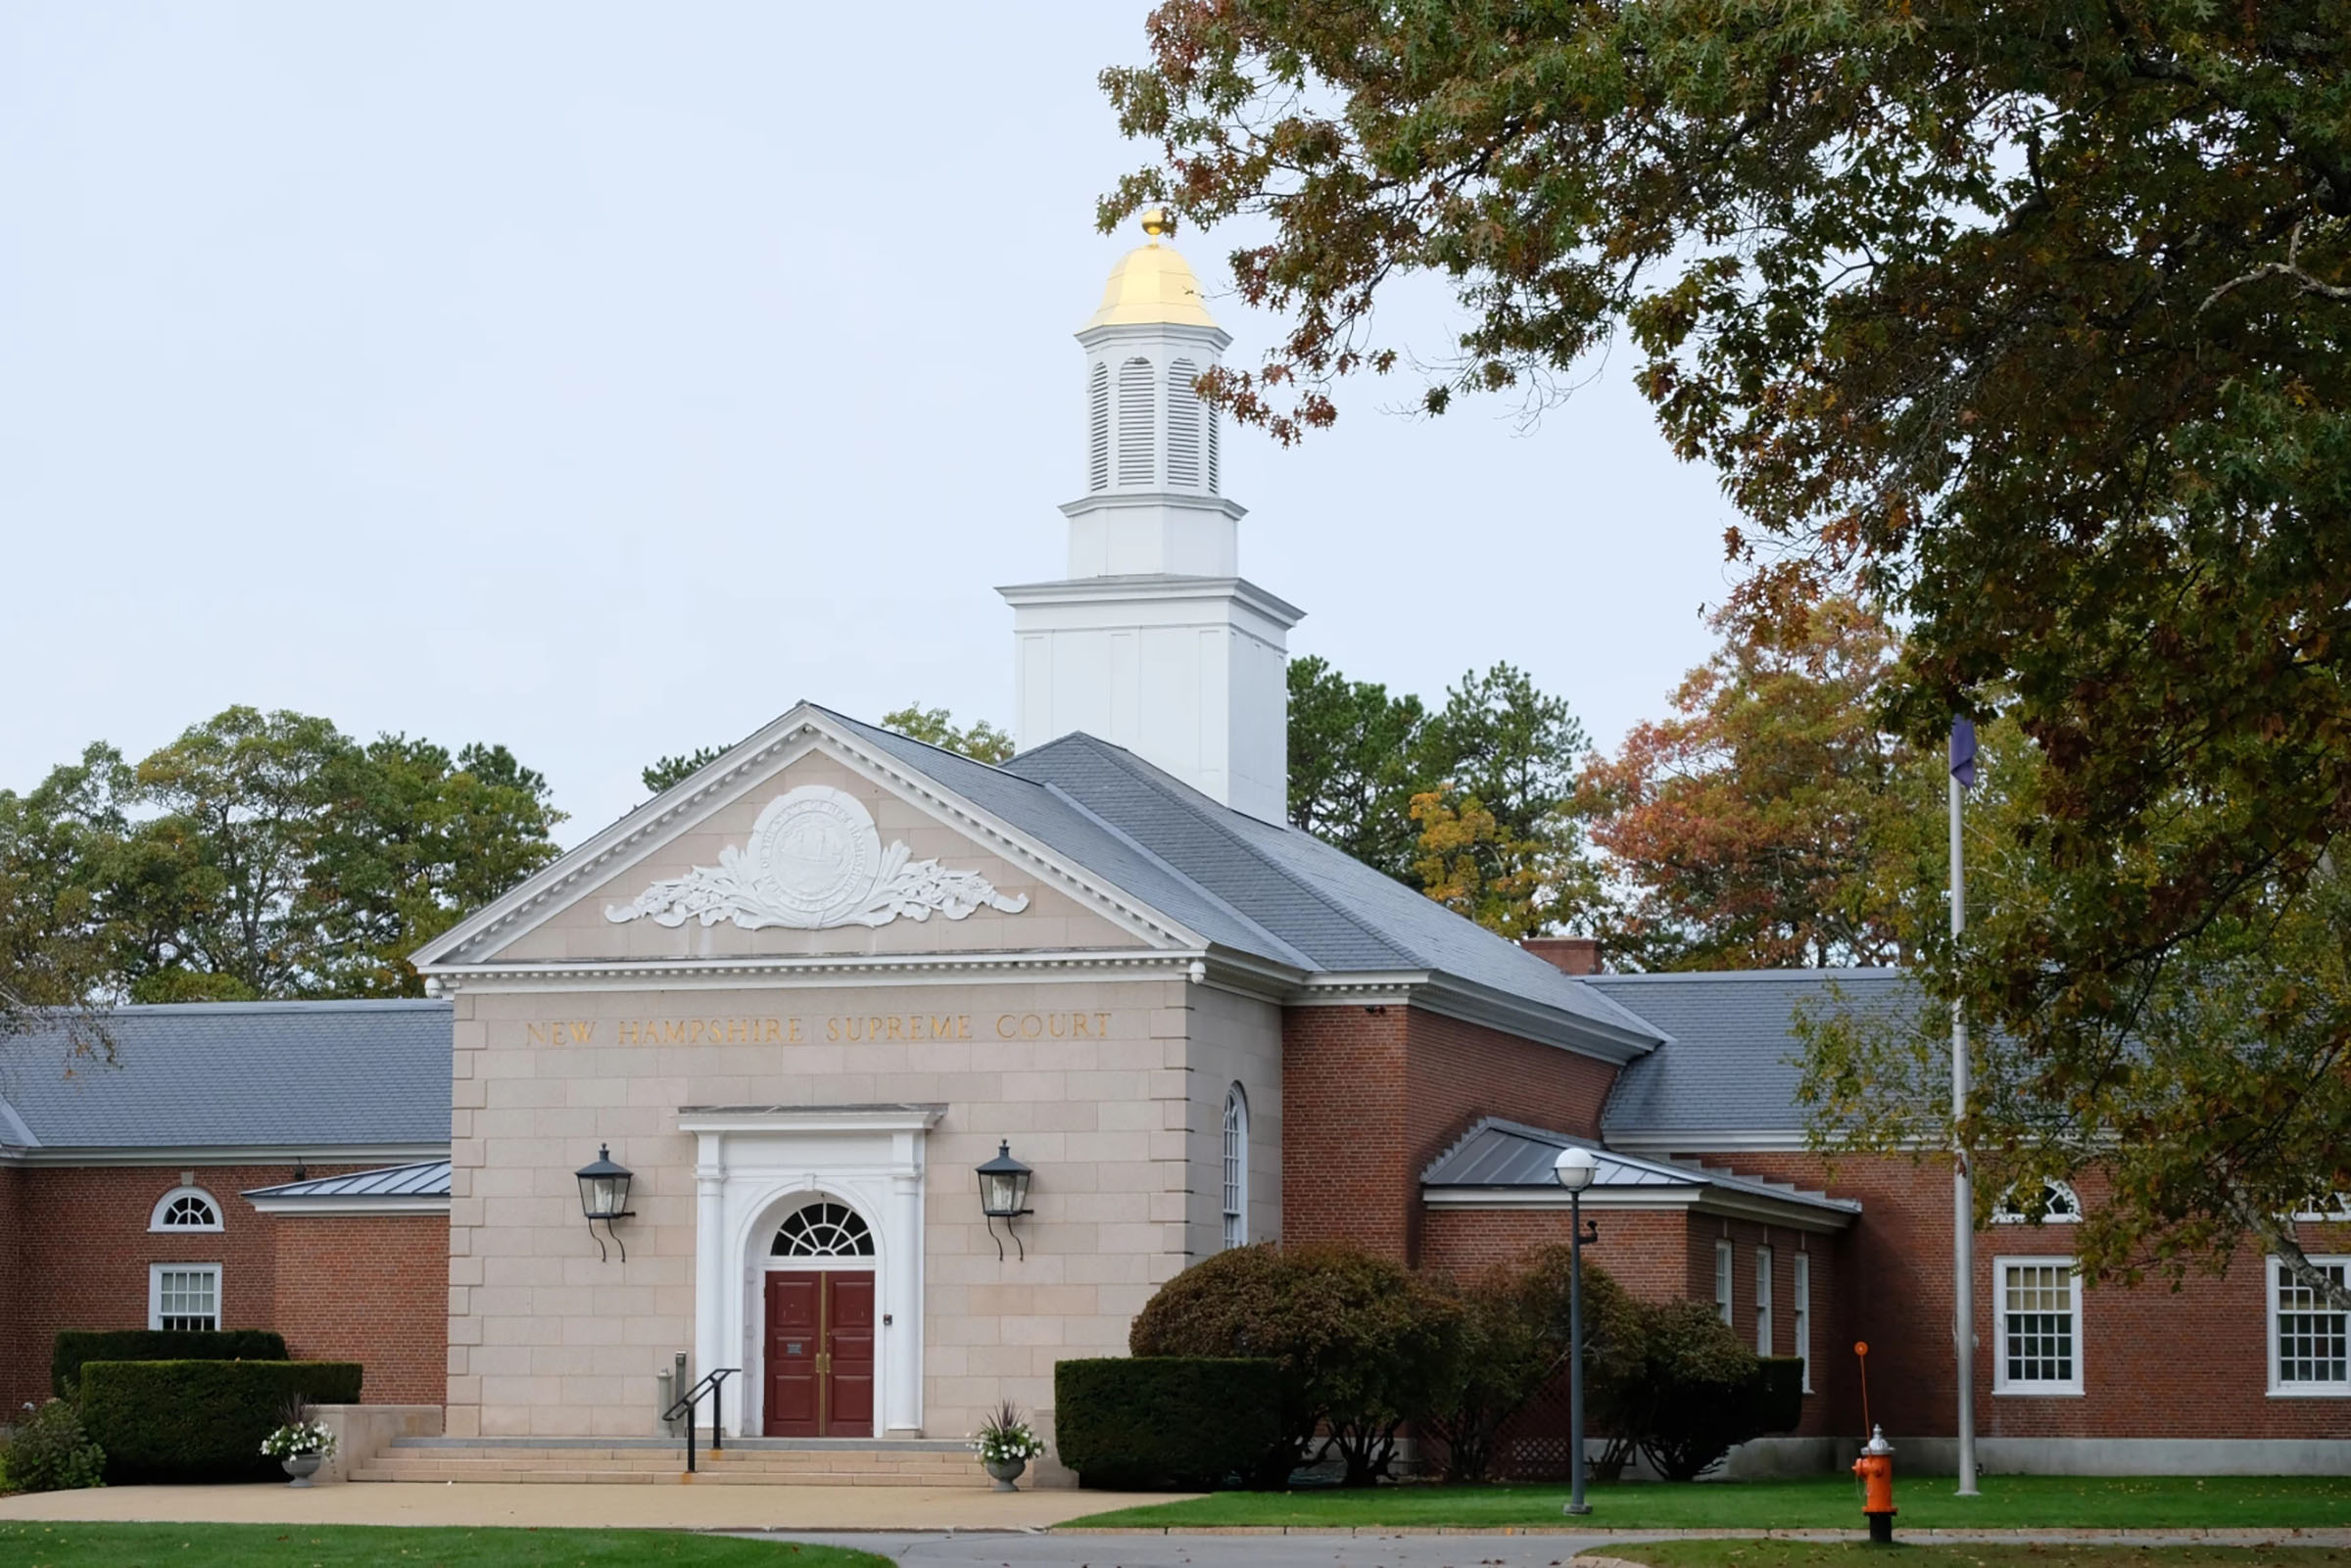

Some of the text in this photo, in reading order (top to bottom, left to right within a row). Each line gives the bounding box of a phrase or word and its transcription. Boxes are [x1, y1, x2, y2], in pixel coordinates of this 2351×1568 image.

[525, 1013, 1112, 1046] NEW HAMPSHIRE SUPREME COURT
